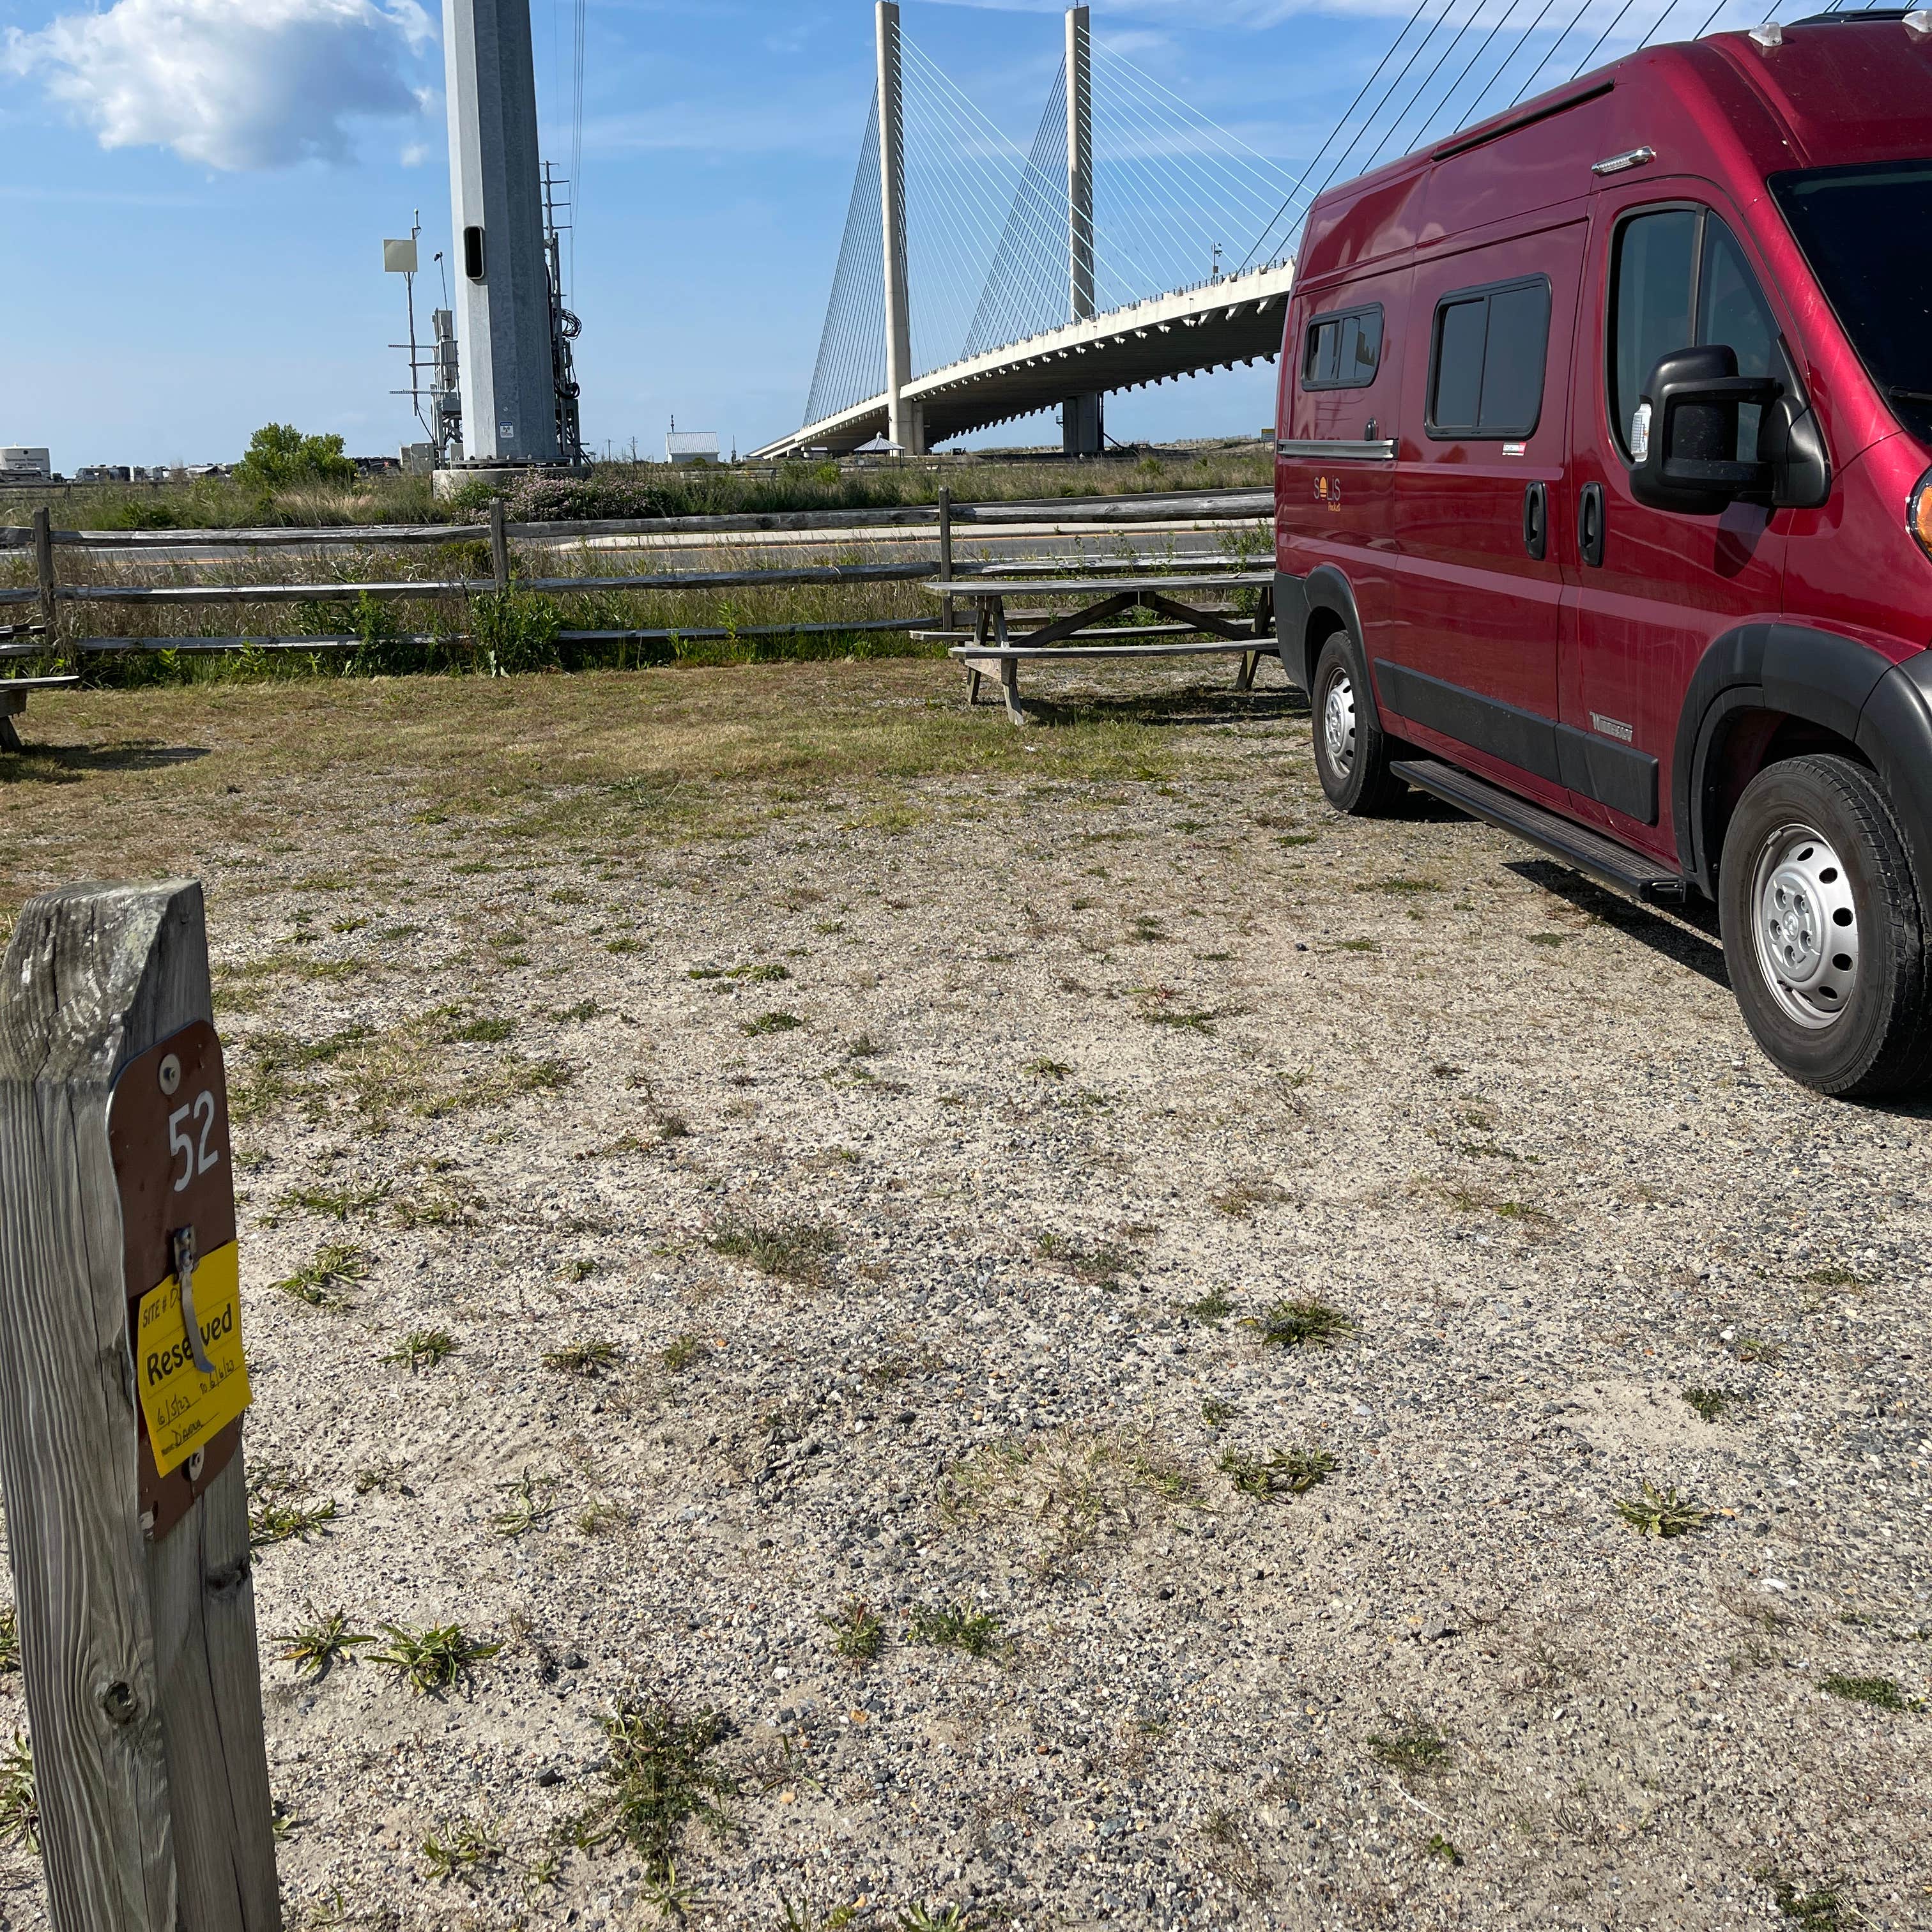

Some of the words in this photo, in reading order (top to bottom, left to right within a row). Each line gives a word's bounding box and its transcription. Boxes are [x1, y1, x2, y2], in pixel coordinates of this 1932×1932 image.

[168, 1090, 219, 1192] 52
[142, 1298, 160, 1328] SITE
[146, 1303, 233, 1386] Reseved
